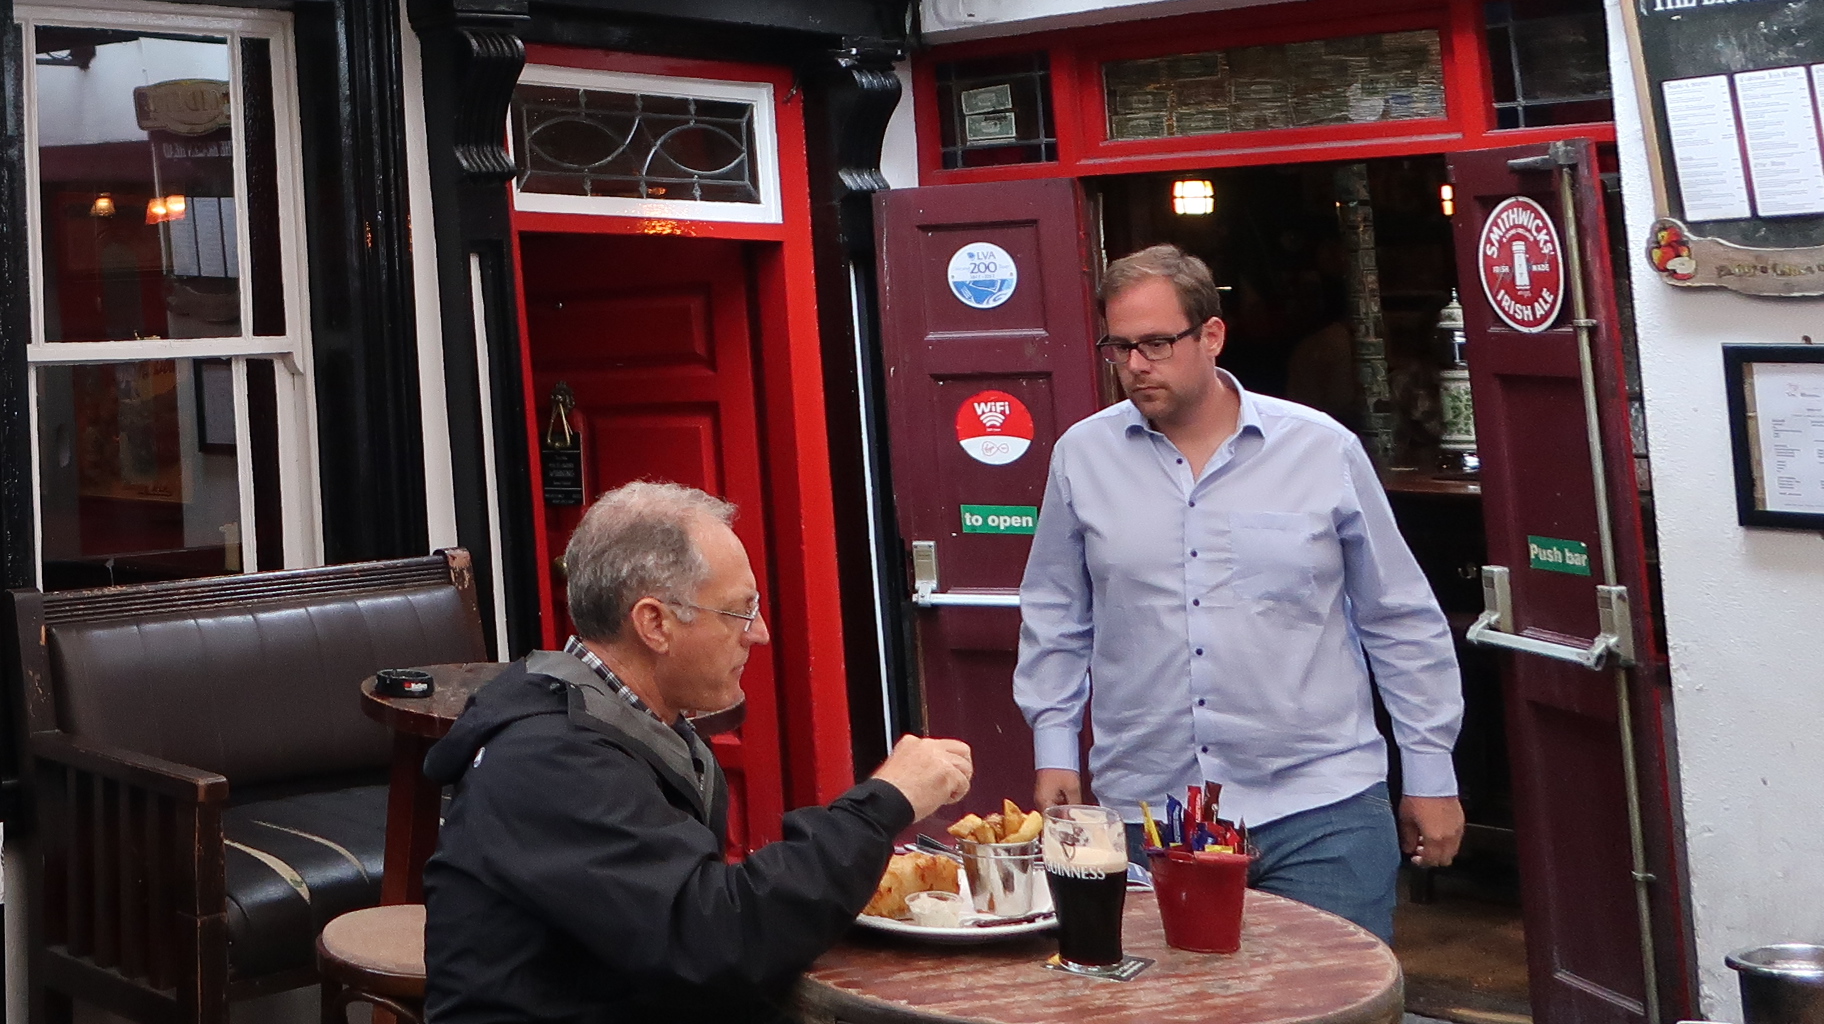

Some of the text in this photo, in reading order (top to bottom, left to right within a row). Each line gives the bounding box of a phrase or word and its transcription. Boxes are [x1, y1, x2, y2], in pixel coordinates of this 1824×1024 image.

[976, 251, 997, 260] LVA
[970, 261, 998, 274] 200
[1496, 288, 1554, 321] IRISH ALE
[973, 401, 1010, 415] WiFi
[964, 512, 1033, 530] to open
[1529, 543, 1587, 566] Push bar
[1046, 861, 1106, 881] GUINNESS
